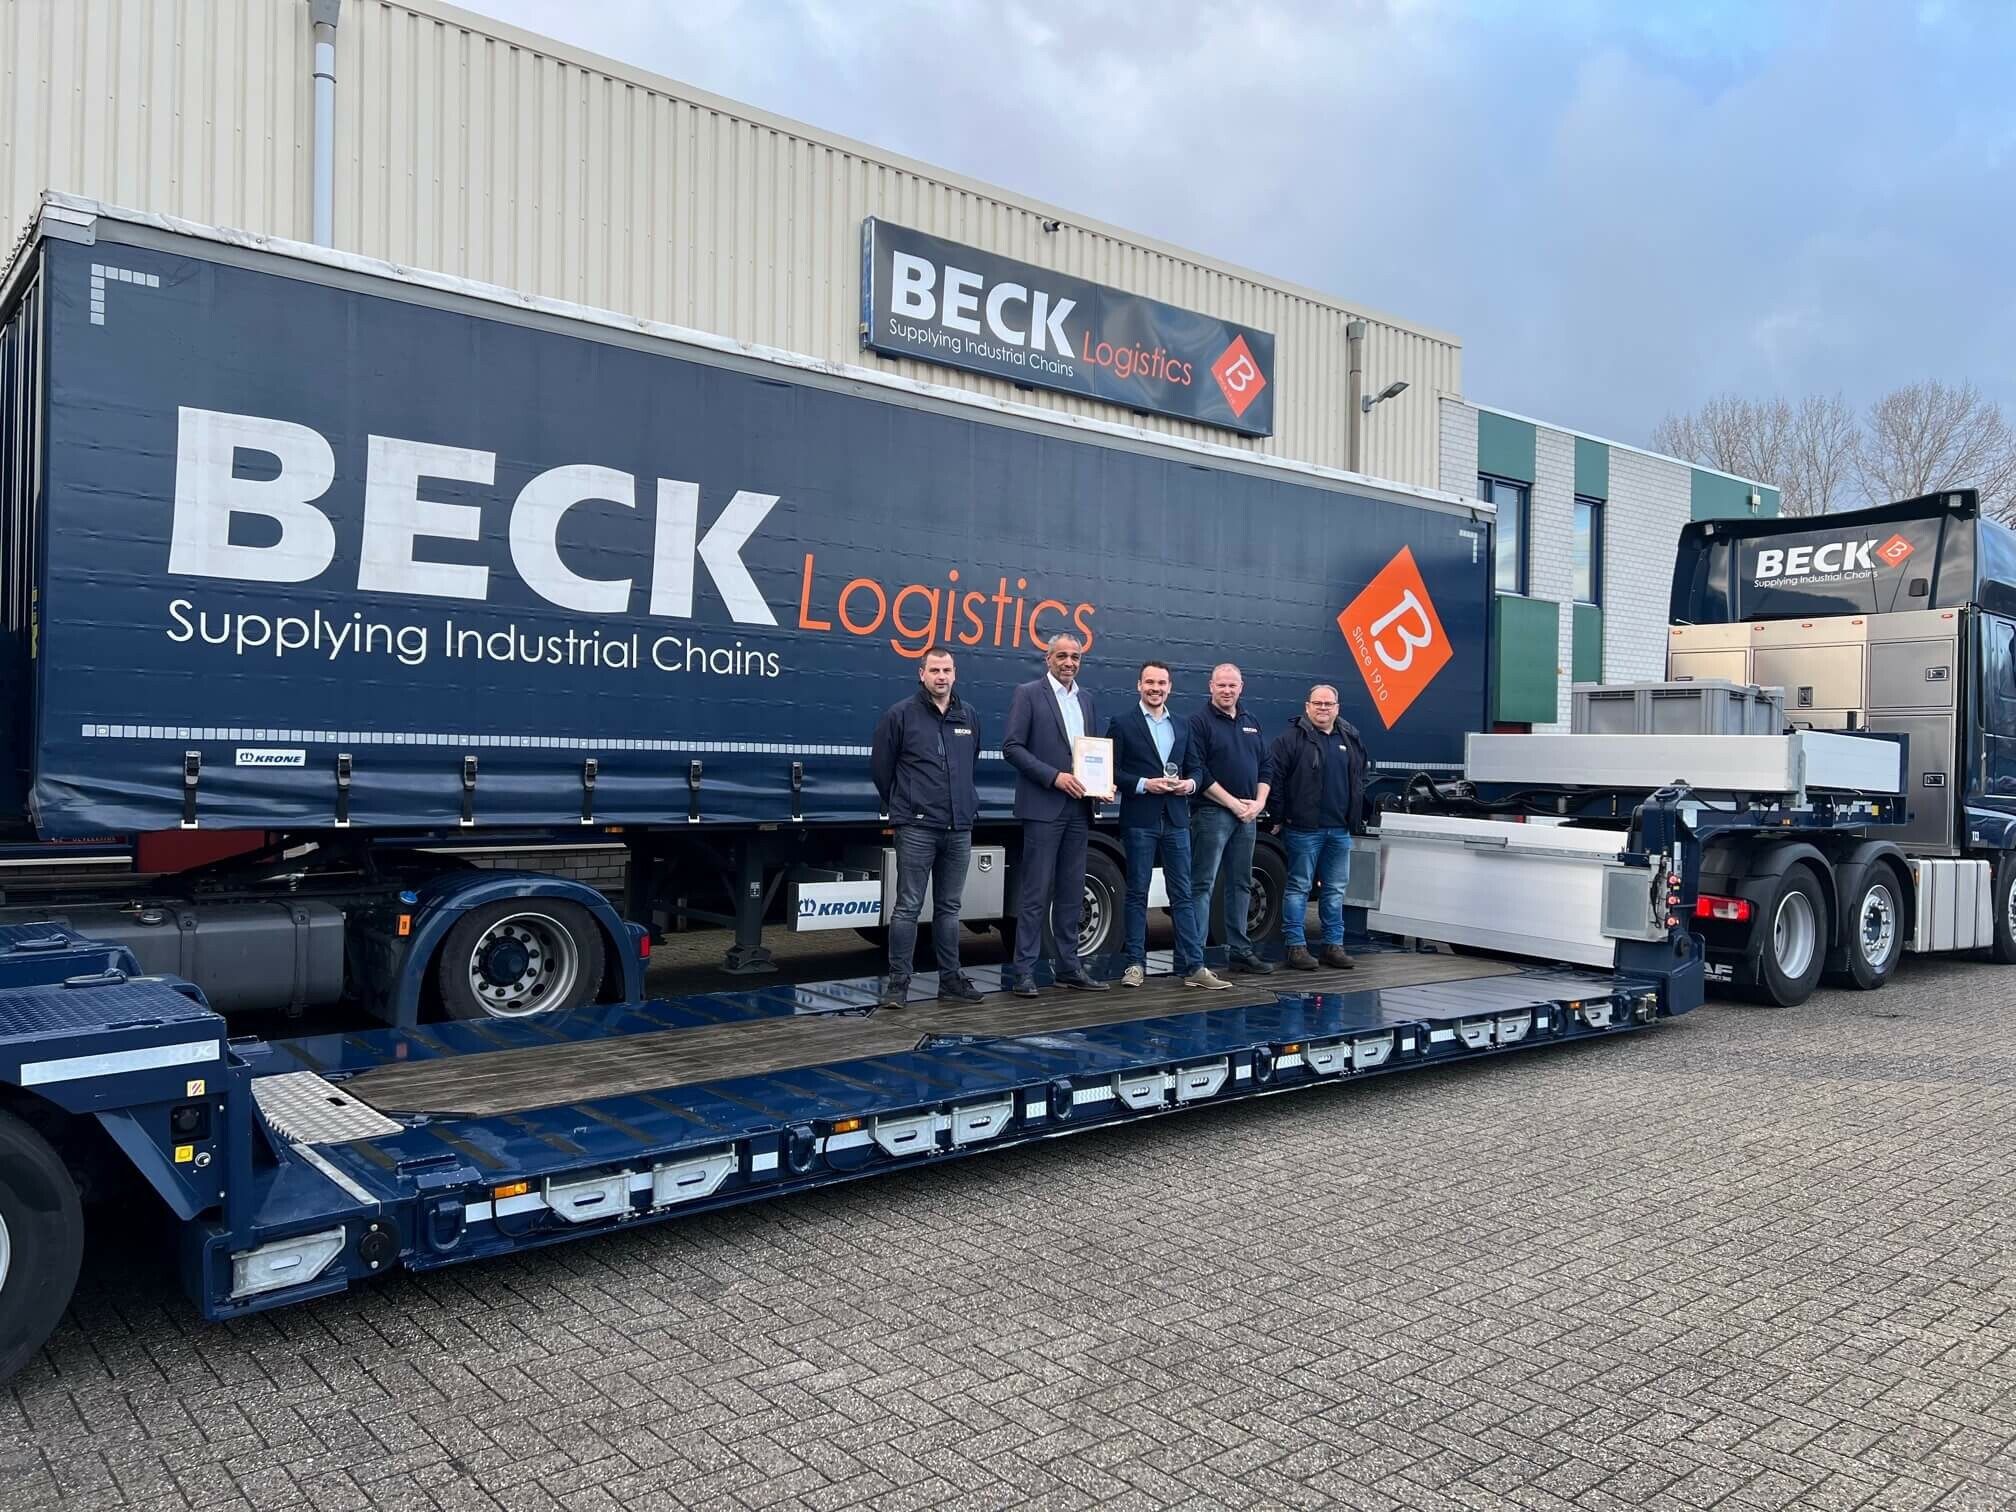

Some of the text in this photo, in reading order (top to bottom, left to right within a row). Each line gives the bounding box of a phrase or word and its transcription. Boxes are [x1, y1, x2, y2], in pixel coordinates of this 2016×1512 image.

[891, 250, 1077, 359] BECK
[889, 318, 1074, 377] Supplying Industrial Chains
[1083, 331, 1193, 386] Logistics
[168, 405, 781, 626] BECK
[1754, 577, 1798, 588] Supplying
[1800, 573, 1842, 583] Industrial
[1755, 539, 1879, 579] BECK
[799, 553, 1096, 659] Logistics
[166, 599, 780, 678] Supplying Industrial Chains
[1352, 625, 1388, 701] Since 1910
[254, 755, 302, 763] KRONE
[818, 900, 881, 916] KRONE
[1704, 962, 1733, 974] AF
